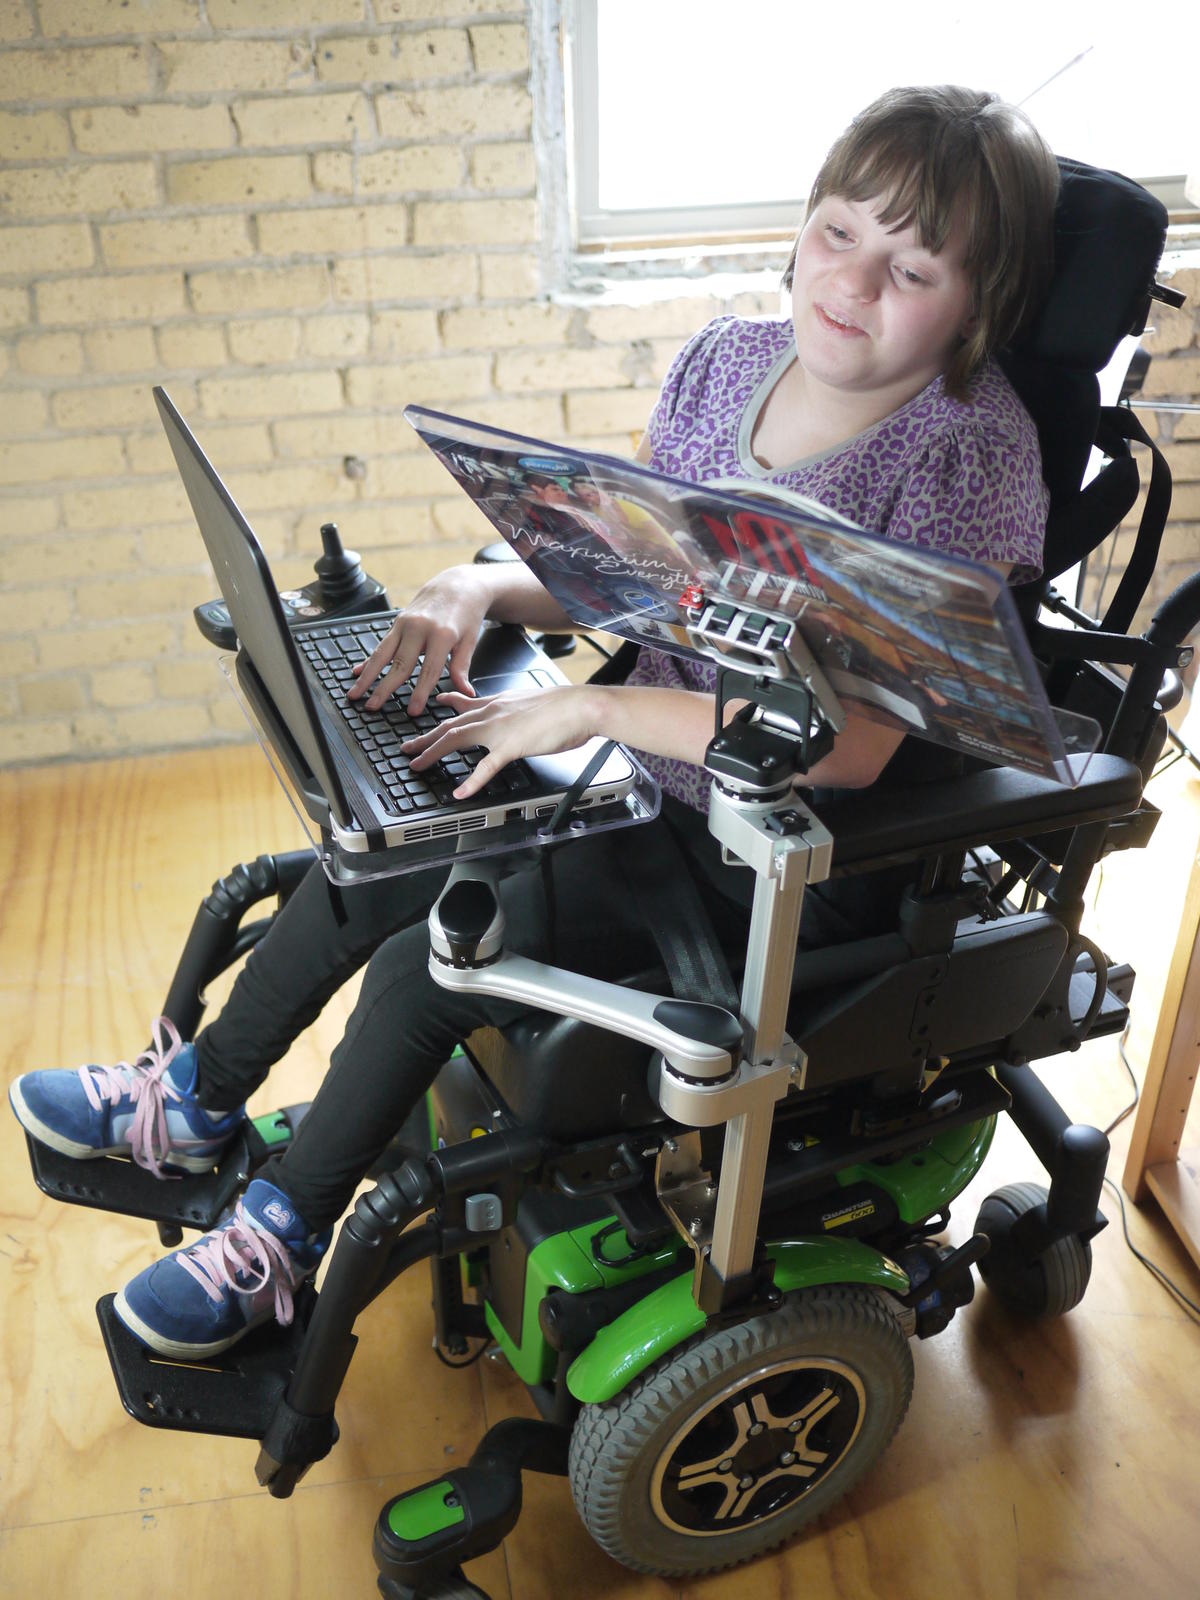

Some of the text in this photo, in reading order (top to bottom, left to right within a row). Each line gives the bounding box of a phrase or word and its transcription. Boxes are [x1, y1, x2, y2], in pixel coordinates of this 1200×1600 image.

[498, 519, 683, 572] Maximum
[595, 560, 703, 590] Everyth
[822, 1199, 873, 1221] QUANTUM
